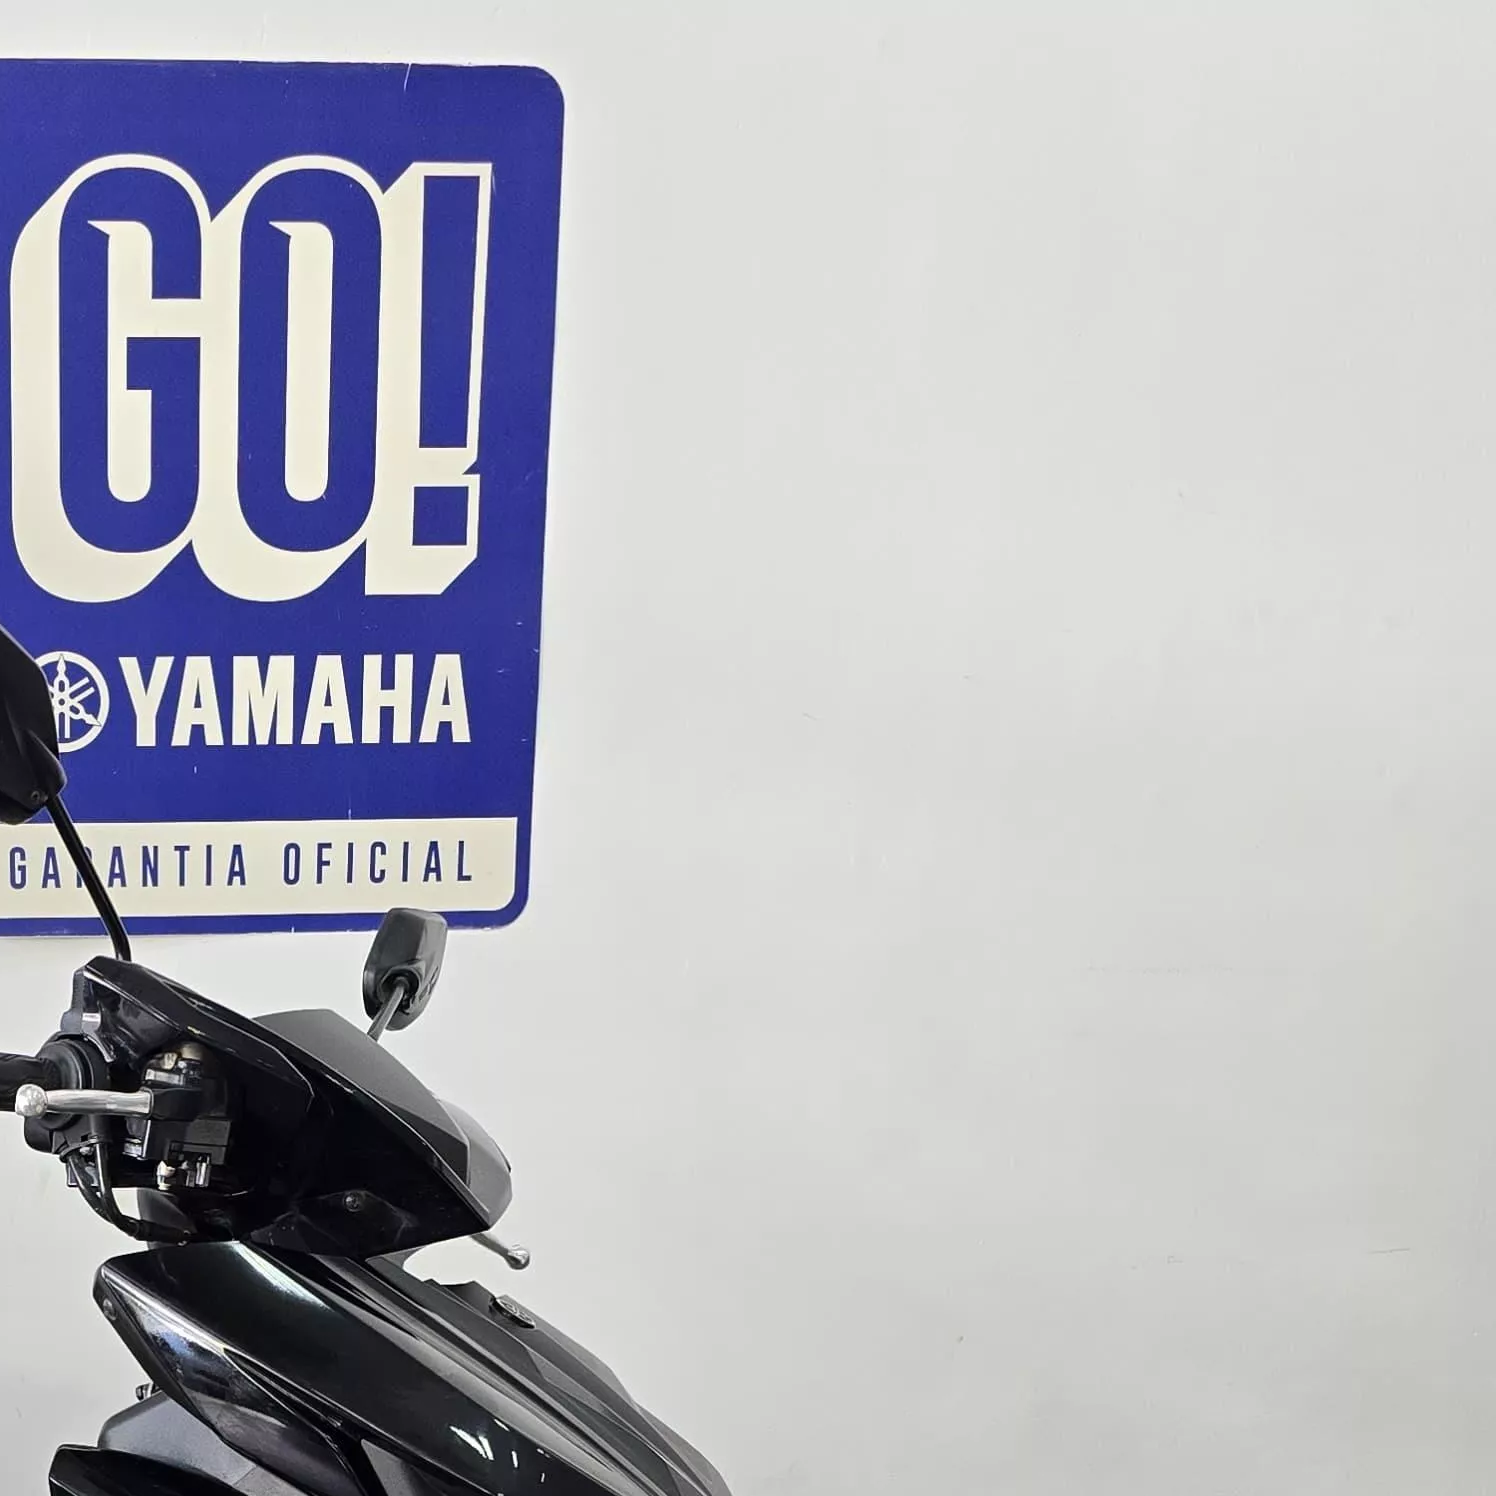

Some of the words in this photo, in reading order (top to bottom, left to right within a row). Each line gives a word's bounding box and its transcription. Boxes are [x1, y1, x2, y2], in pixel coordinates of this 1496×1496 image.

[10, 153, 493, 602] GO!
[118, 652, 472, 748] YAMAHA
[283, 840, 472, 885] OFICIAL
